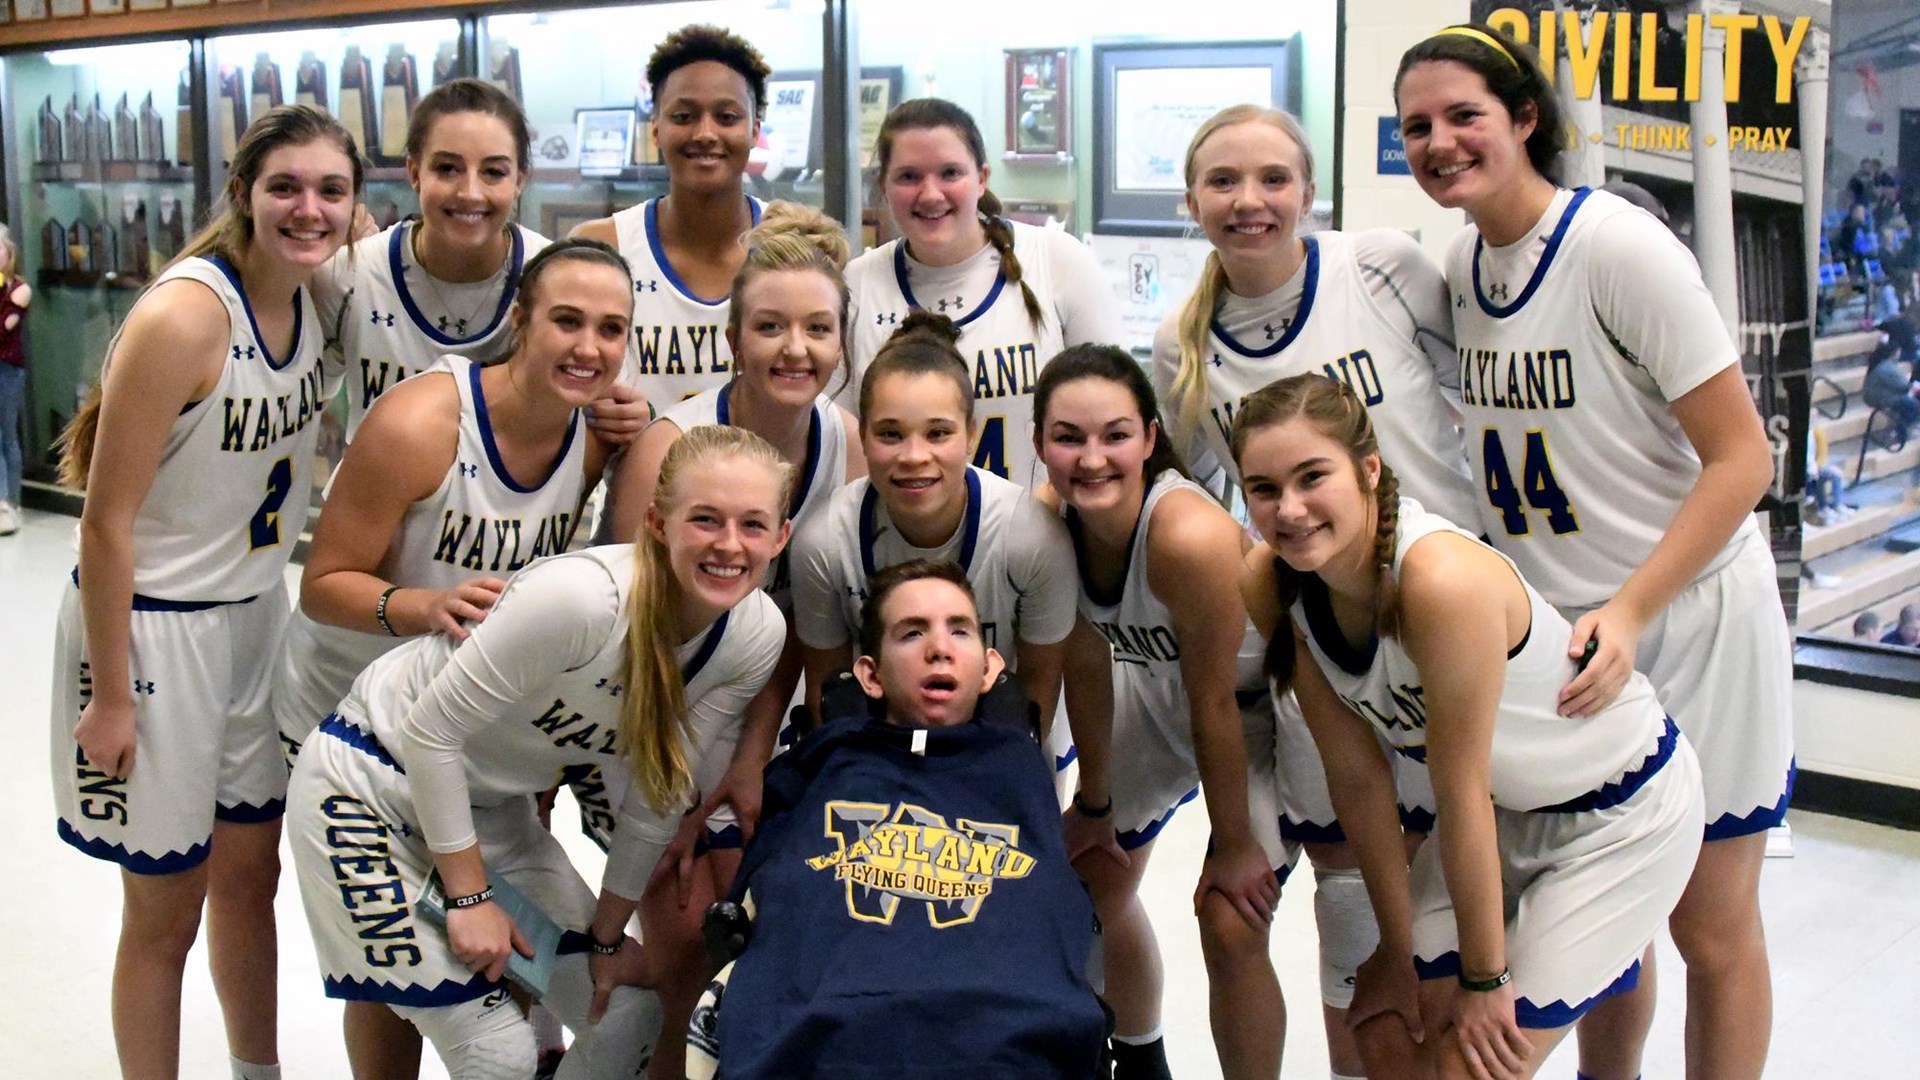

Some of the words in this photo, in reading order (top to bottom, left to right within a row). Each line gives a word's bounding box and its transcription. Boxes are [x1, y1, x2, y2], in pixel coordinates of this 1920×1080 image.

[1615, 124, 1691, 150] THINK
[1728, 126, 1792, 152] PRAY
[635, 325, 730, 375] WAYL
[1460, 348, 1577, 410] AYLAND
[249, 455, 295, 552] 2
[1482, 425, 1582, 538] 44
[433, 510, 570, 572] WAYLAN
[319, 795, 423, 968] QUEENS
[804, 828, 1038, 880] WAYLAND
[837, 864, 908, 890] FLYING
[912, 873, 991, 900] QUEENS
